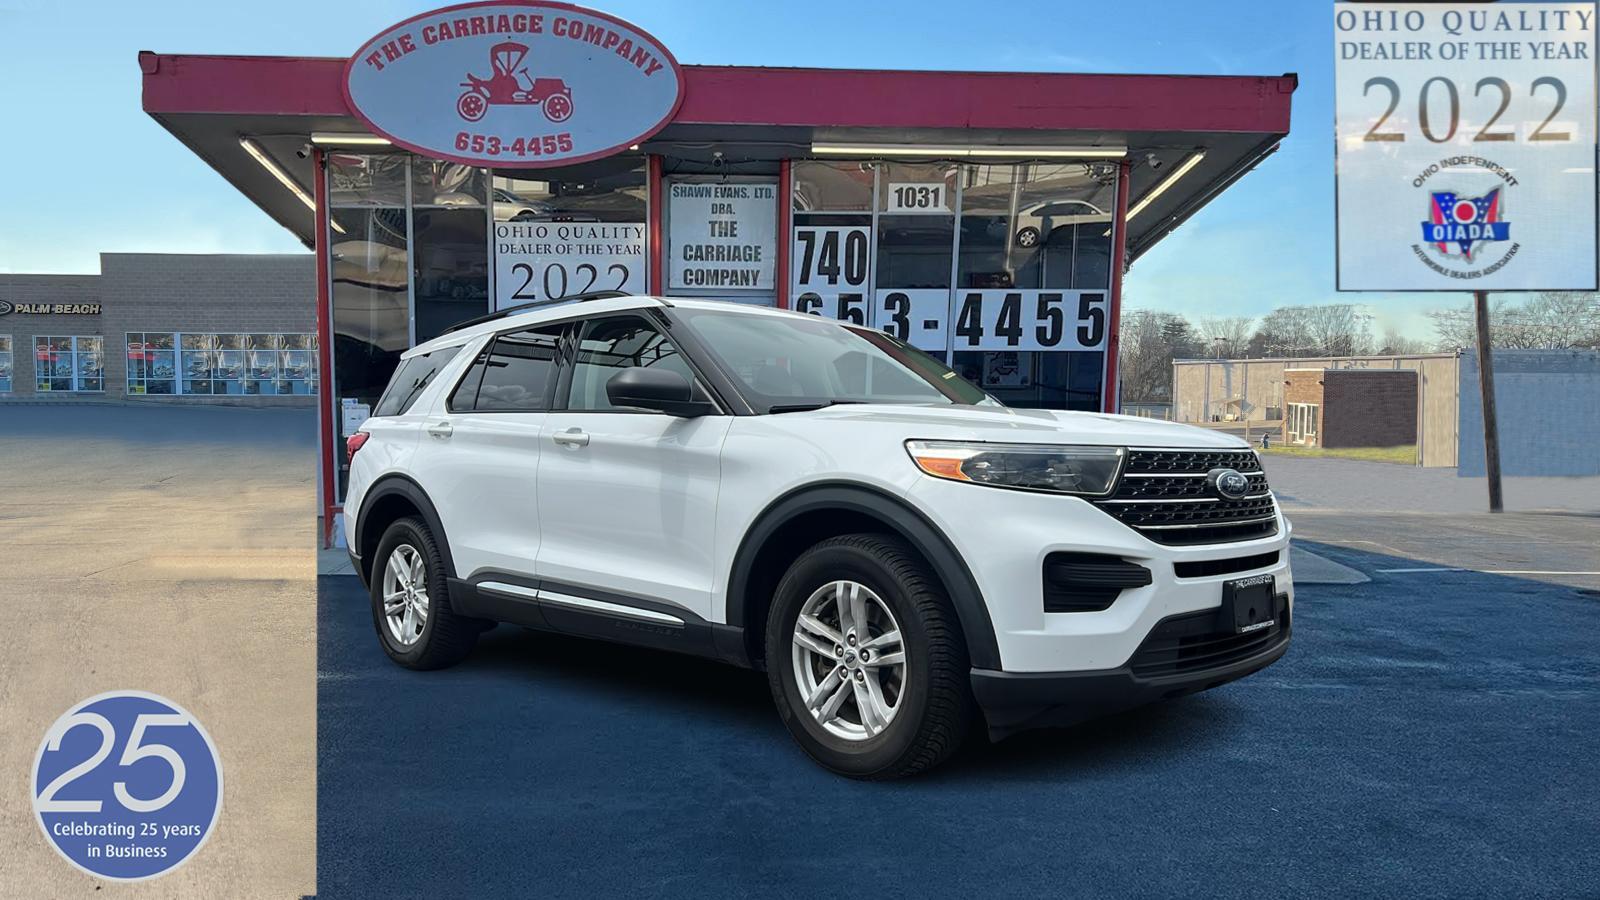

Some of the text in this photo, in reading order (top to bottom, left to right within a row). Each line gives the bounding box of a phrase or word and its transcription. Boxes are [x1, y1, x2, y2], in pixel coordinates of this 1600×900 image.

[1336, 10, 1592, 36] OHIO QUALITY
[365, 14, 664, 77] THE CARRIAGE COMPANY
[1340, 42, 1589, 60] DEALER OF THE YEAR
[1362, 76, 1571, 143] 2022
[455, 132, 573, 156] 653-4455
[1412, 156, 1519, 188] OHIO INDEPENDENT
[672, 186, 775, 199] SHAWN EVANS. LTD.
[894, 186, 941, 208] 1031
[711, 203, 735, 215] DBA.
[497, 226, 643, 241] OHIO QUALITY
[708, 220, 738, 237] THE
[1432, 225, 1495, 240] OIADA
[500, 244, 641, 255] DEALER OF THE YEAR
[683, 244, 762, 262] CARRIAGE
[797, 230, 868, 285] 740
[1411, 242, 1521, 279] AUTOMOBILE DEALERS ASSOCIATION
[511, 263, 630, 300] 2022
[683, 269, 760, 286] COMPANY
[14, 303, 51, 314] PALM
[54, 303, 100, 314] BEACH
